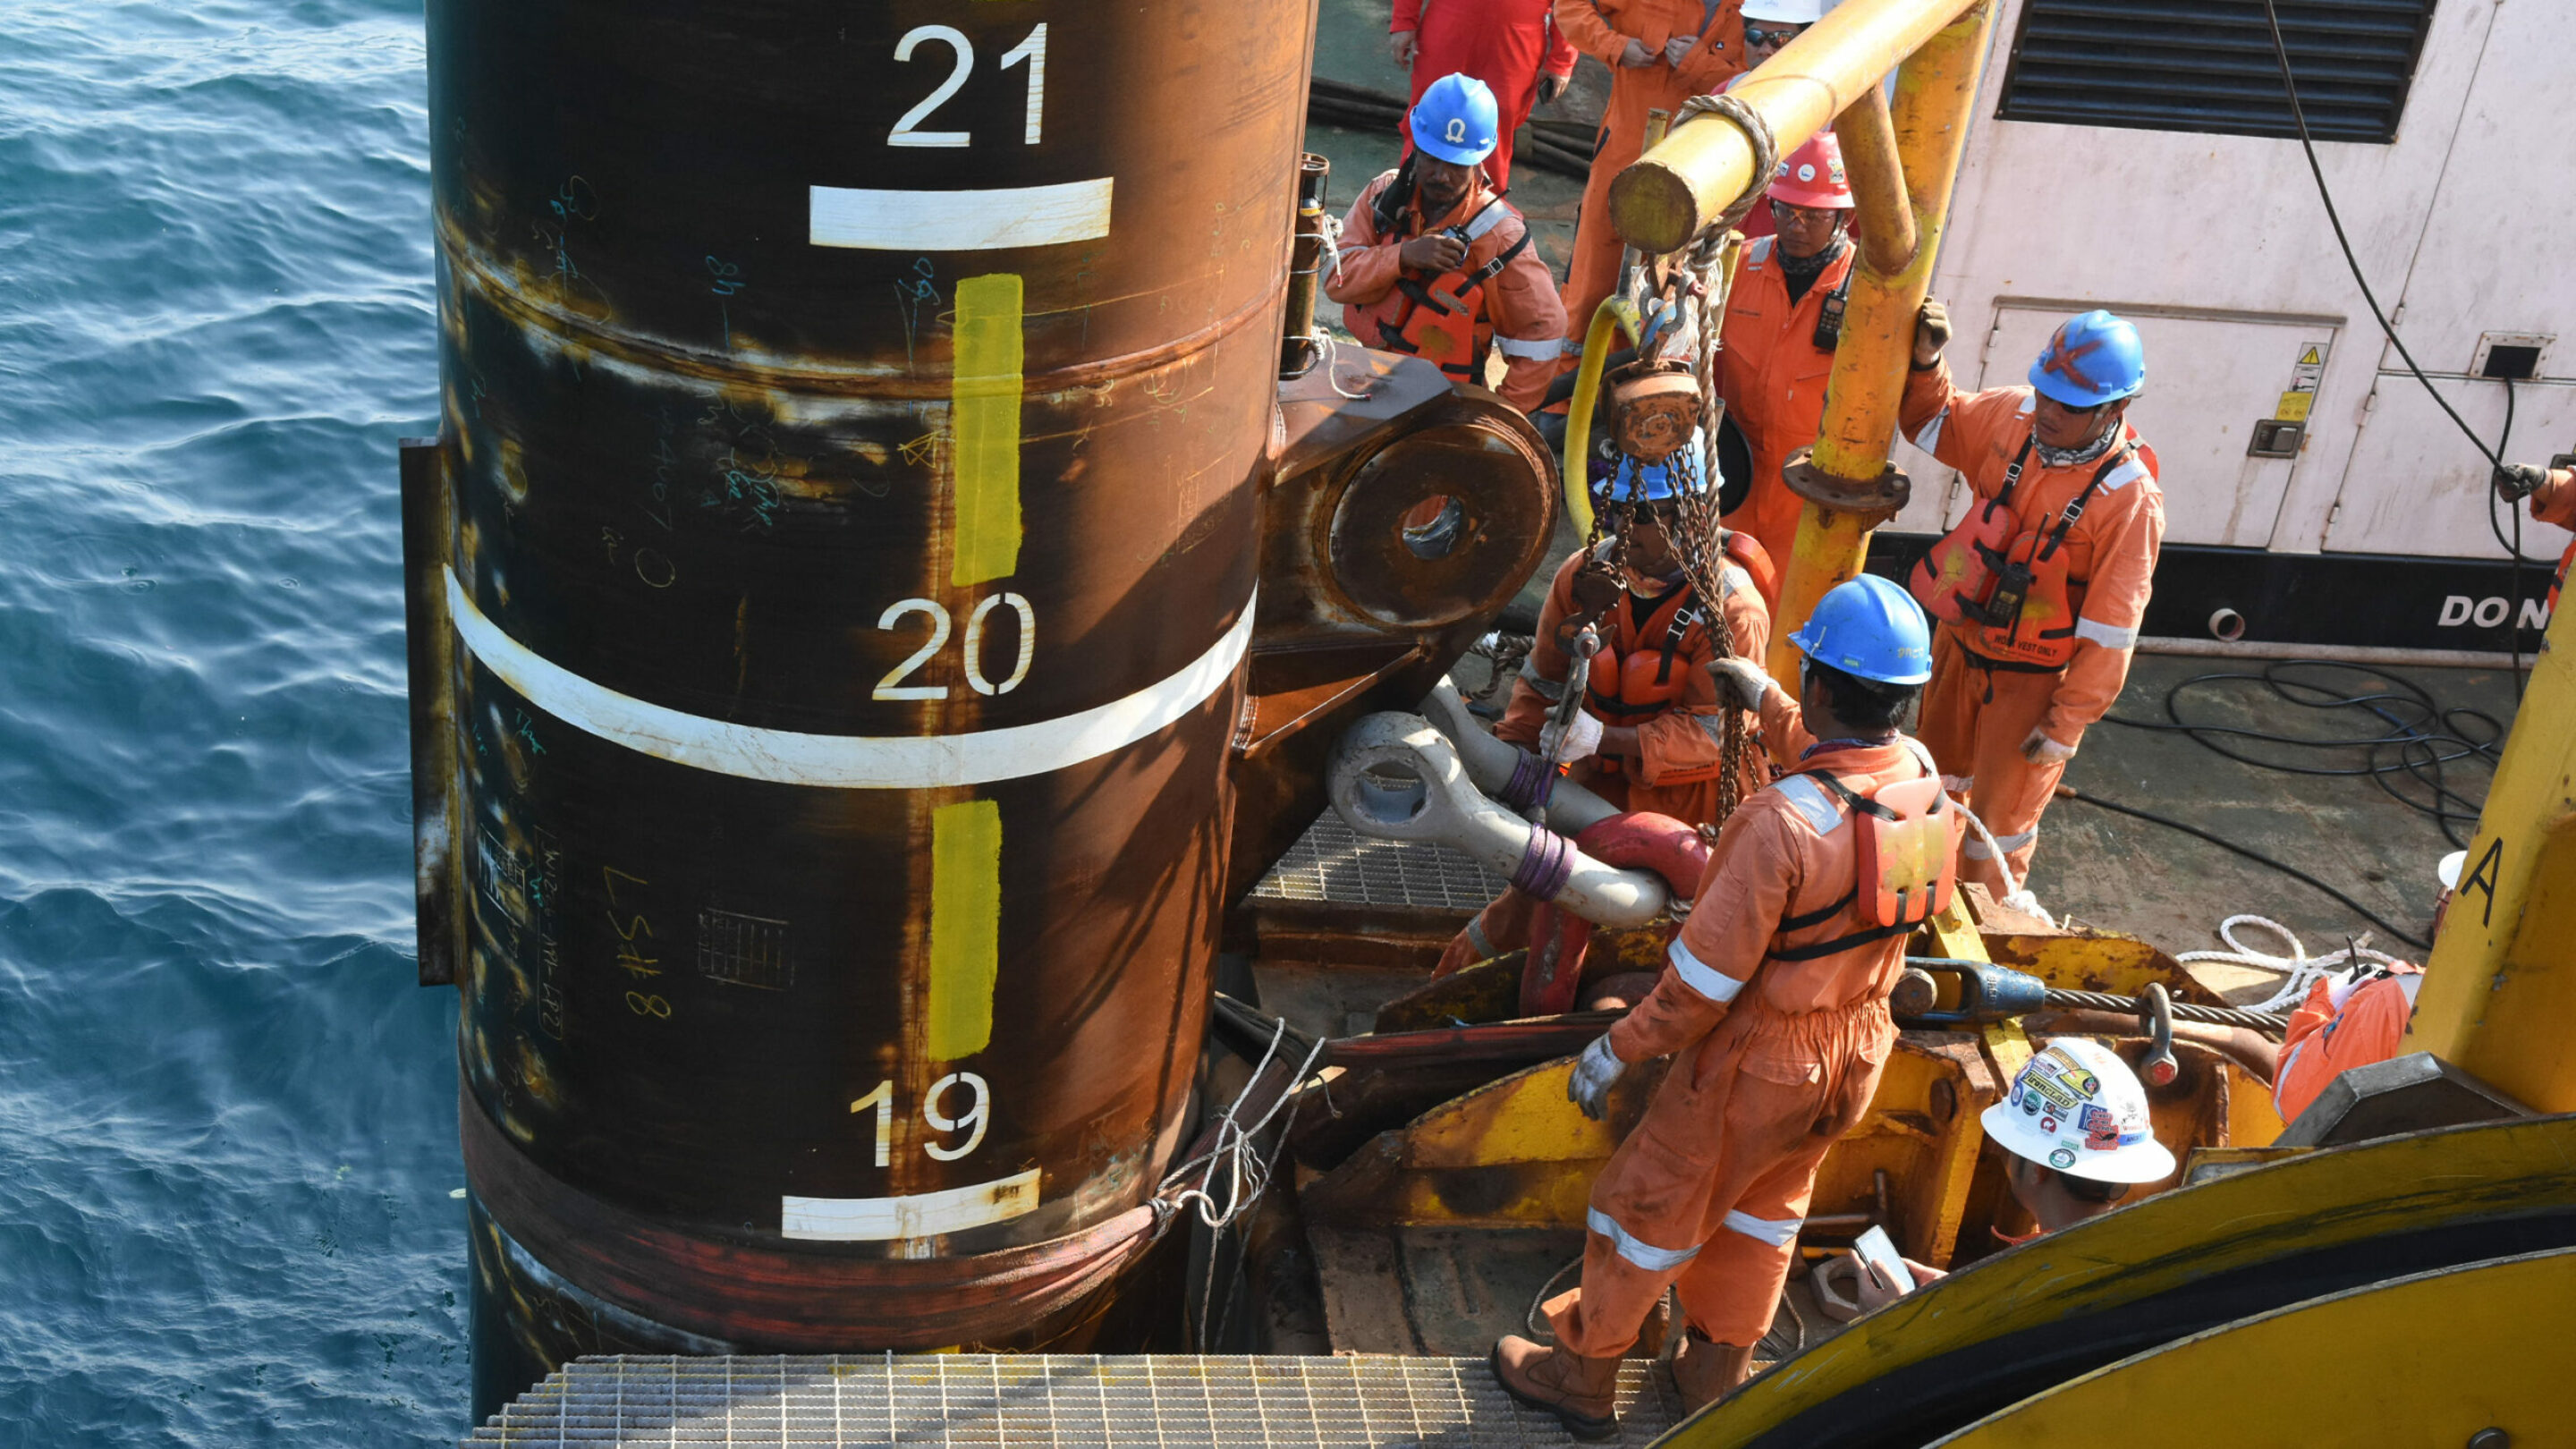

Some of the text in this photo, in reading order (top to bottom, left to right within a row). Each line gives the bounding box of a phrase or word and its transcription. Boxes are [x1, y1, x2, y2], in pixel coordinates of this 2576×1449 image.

[887, 23, 1046, 147] 21
[874, 593, 1034, 699] 20
[2437, 595, 2510, 629] DO
[2460, 836, 2504, 929] A
[851, 1072, 988, 1166] 19
